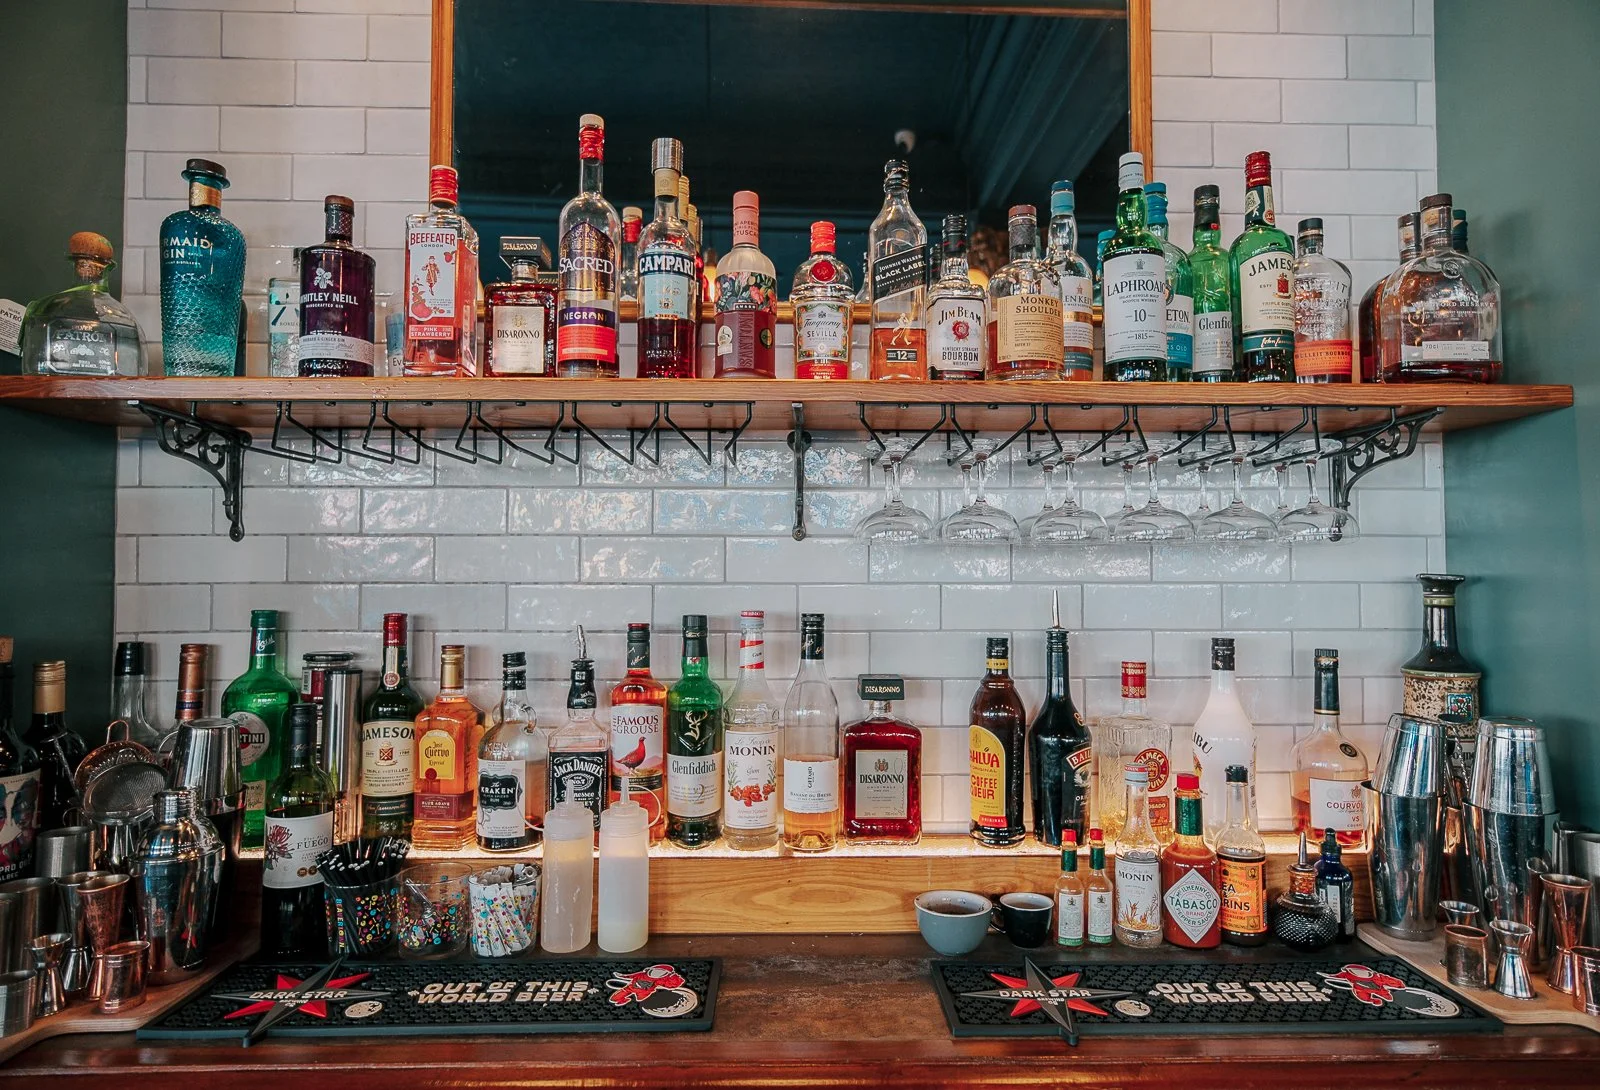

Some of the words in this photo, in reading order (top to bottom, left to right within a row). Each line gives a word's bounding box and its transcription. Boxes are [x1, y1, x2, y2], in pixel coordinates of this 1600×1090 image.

[410, 233, 455, 246] BEEFEATER
[164, 248, 185, 259] GIN
[560, 256, 614, 274] SACRED
[640, 255, 694, 276] CAMPARI
[879, 261, 901, 272] JOHNNIE
[875, 268, 901, 282] BLACK
[903, 261, 927, 272] LABEL
[332, 292, 358, 306] NEILL
[1021, 296, 1058, 307] MONKEY
[938, 310, 955, 325] JIM
[958, 306, 981, 326] BEAM
[1016, 306, 1061, 317] SHOULDER
[1134, 308, 1146, 322] 10
[804, 319, 840, 328] Tanqueray
[497, 330, 540, 339] DISARONNO
[896, 350, 908, 360] 12
[942, 352, 978, 361] BOURBON
[617, 715, 659, 725] FAMOUS
[616, 724, 659, 735] GROUSE
[425, 746, 449, 758] Cuervo
[730, 746, 775, 756] MONIN
[554, 762, 574, 778] JACK
[672, 759, 716, 775] Glenfiddich
[860, 774, 904, 784] DISARONNO
[971, 775, 997, 789] COFFEE
[297, 837, 328, 850] FUEGO
[1119, 870, 1152, 881] MONIN
[1170, 896, 1217, 910] TABASCO
[1176, 908, 1196, 925] PEPPER
[1198, 911, 1212, 925] SAUCE
[424, 983, 482, 994] OUT
[488, 982, 517, 992] OF
[526, 981, 589, 992] THIS
[1155, 983, 1209, 993] OUT
[1216, 982, 1246, 992] OF
[1249, 982, 1317, 992] THIS
[418, 993, 508, 1004] WORLD
[515, 992, 584, 1002] BEER
[1163, 992, 1254, 1003] WORLD
[1260, 992, 1330, 1002] BEER
